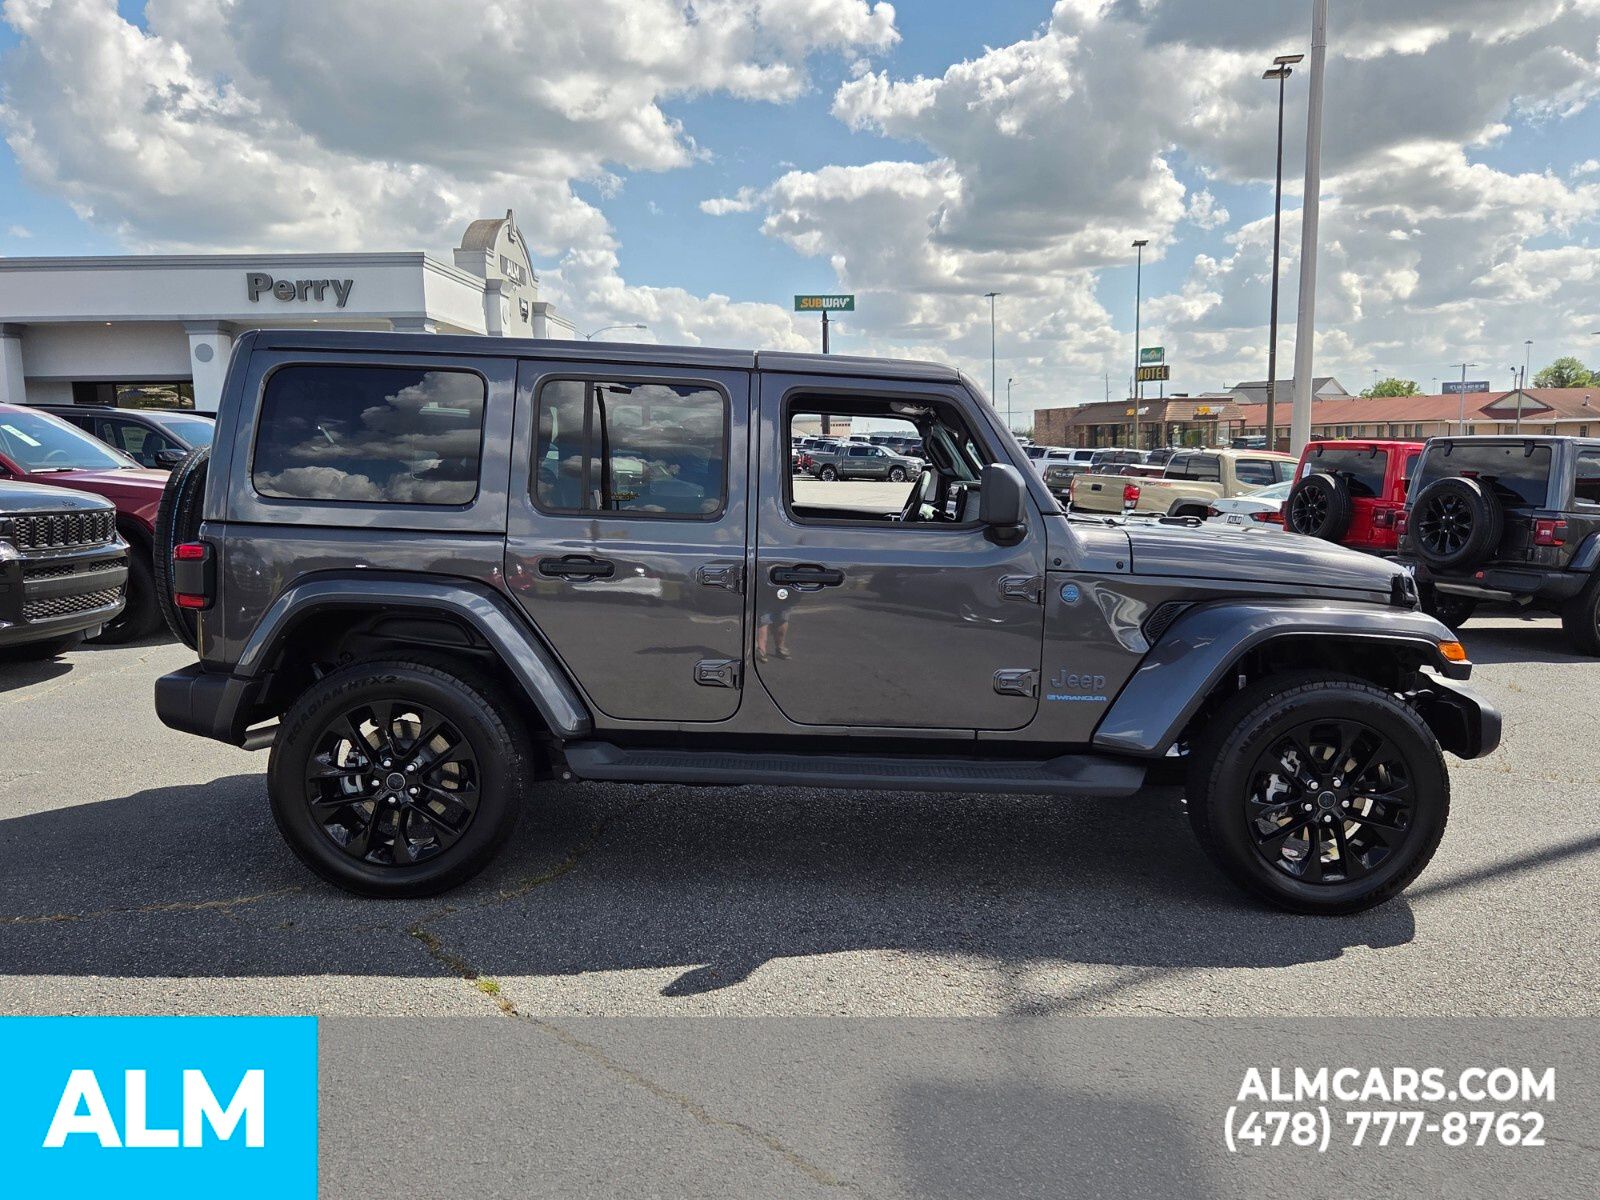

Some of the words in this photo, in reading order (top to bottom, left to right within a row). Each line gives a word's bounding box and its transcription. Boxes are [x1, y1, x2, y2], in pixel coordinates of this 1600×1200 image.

[246, 272, 354, 308] Perry
[800, 297, 849, 308] SUBWAY
[1137, 367, 1167, 380] MOTEL
[1050, 667, 1106, 692] Jeep
